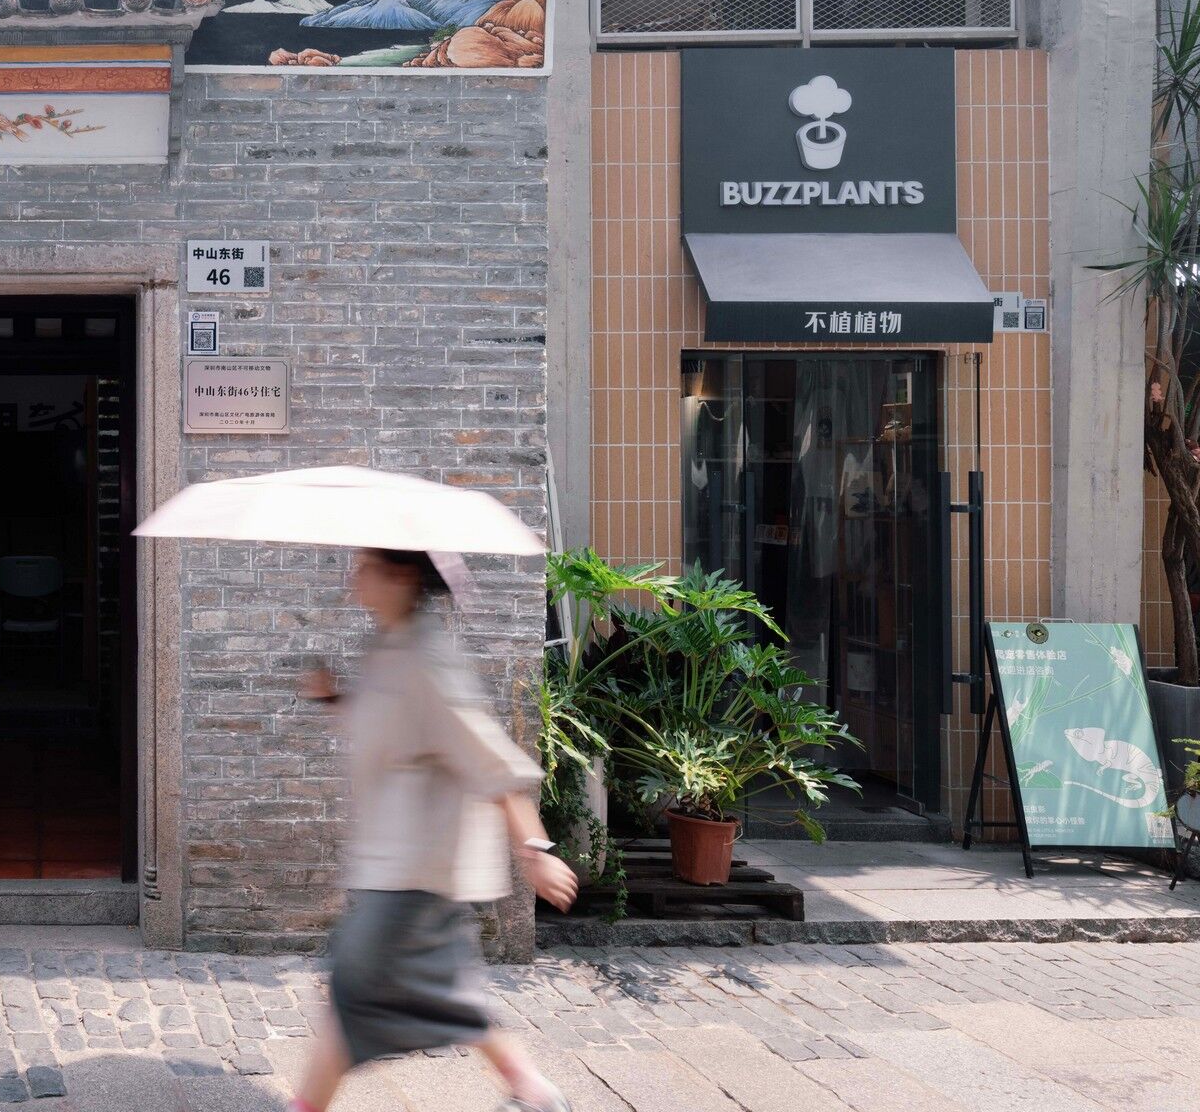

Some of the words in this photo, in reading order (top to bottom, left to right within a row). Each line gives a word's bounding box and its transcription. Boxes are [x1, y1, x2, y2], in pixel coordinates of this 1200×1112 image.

[720, 180, 925, 207] BUZZPLANTS
[193, 247, 244, 261] 中山东街
[206, 268, 231, 285] 46
[804, 311, 902, 334] 不植植物
[194, 385, 281, 398] 中山东街46号住宅
